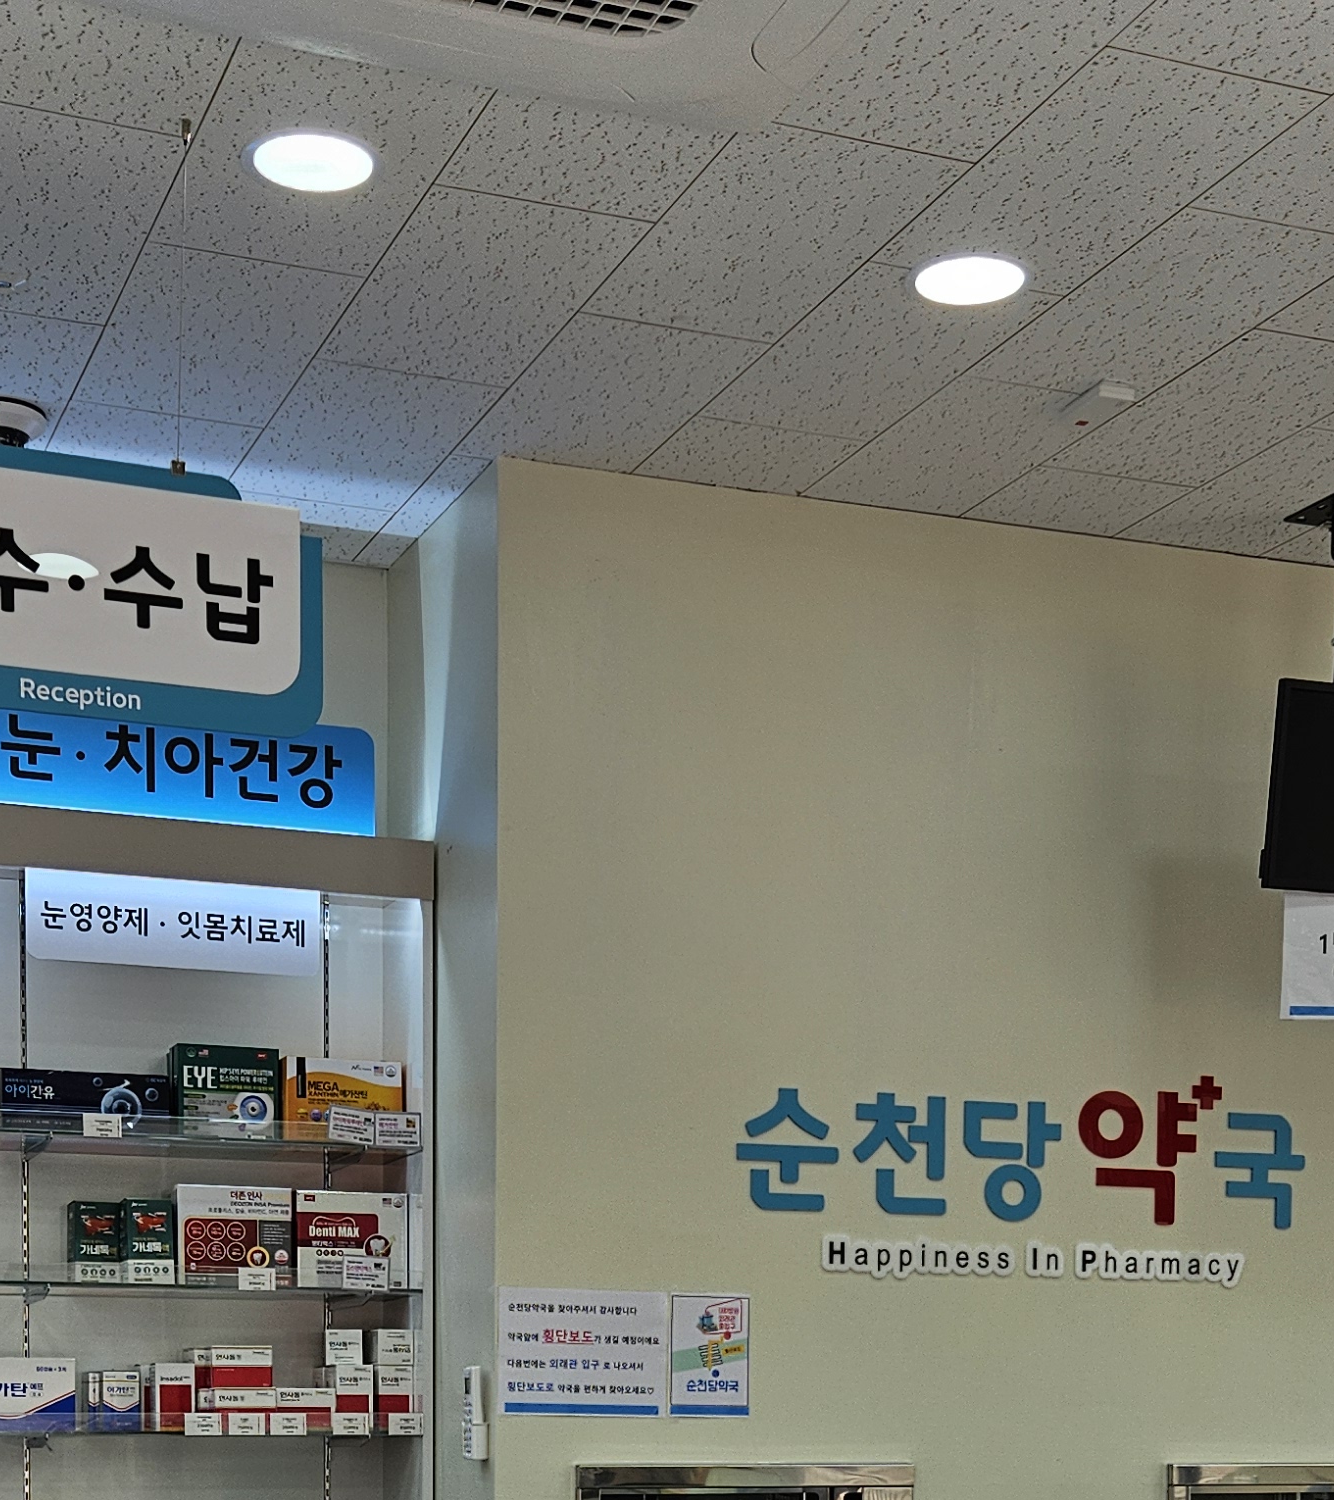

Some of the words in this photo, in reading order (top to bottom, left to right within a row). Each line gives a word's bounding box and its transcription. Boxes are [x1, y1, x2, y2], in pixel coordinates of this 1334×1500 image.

[19, 676, 141, 712] Reception
[40, 900, 151, 937] 눈영양제
[176, 911, 307, 948] 잇몸치료제
[183, 1065, 217, 1089] EYE
[308, 1081, 339, 1092] MEGA
[735, 1087, 1305, 1230] 순천당약국
[309, 1226, 336, 1237] Denti
[338, 1226, 359, 1238] MAX
[827, 1240, 1010, 1274] Happiness
[1031, 1245, 1060, 1273] In
[1080, 1248, 1240, 1283] Pharmacy
[582, 1360, 599, 1370] 입구
[686, 1380, 739, 1393] 순천당약국
